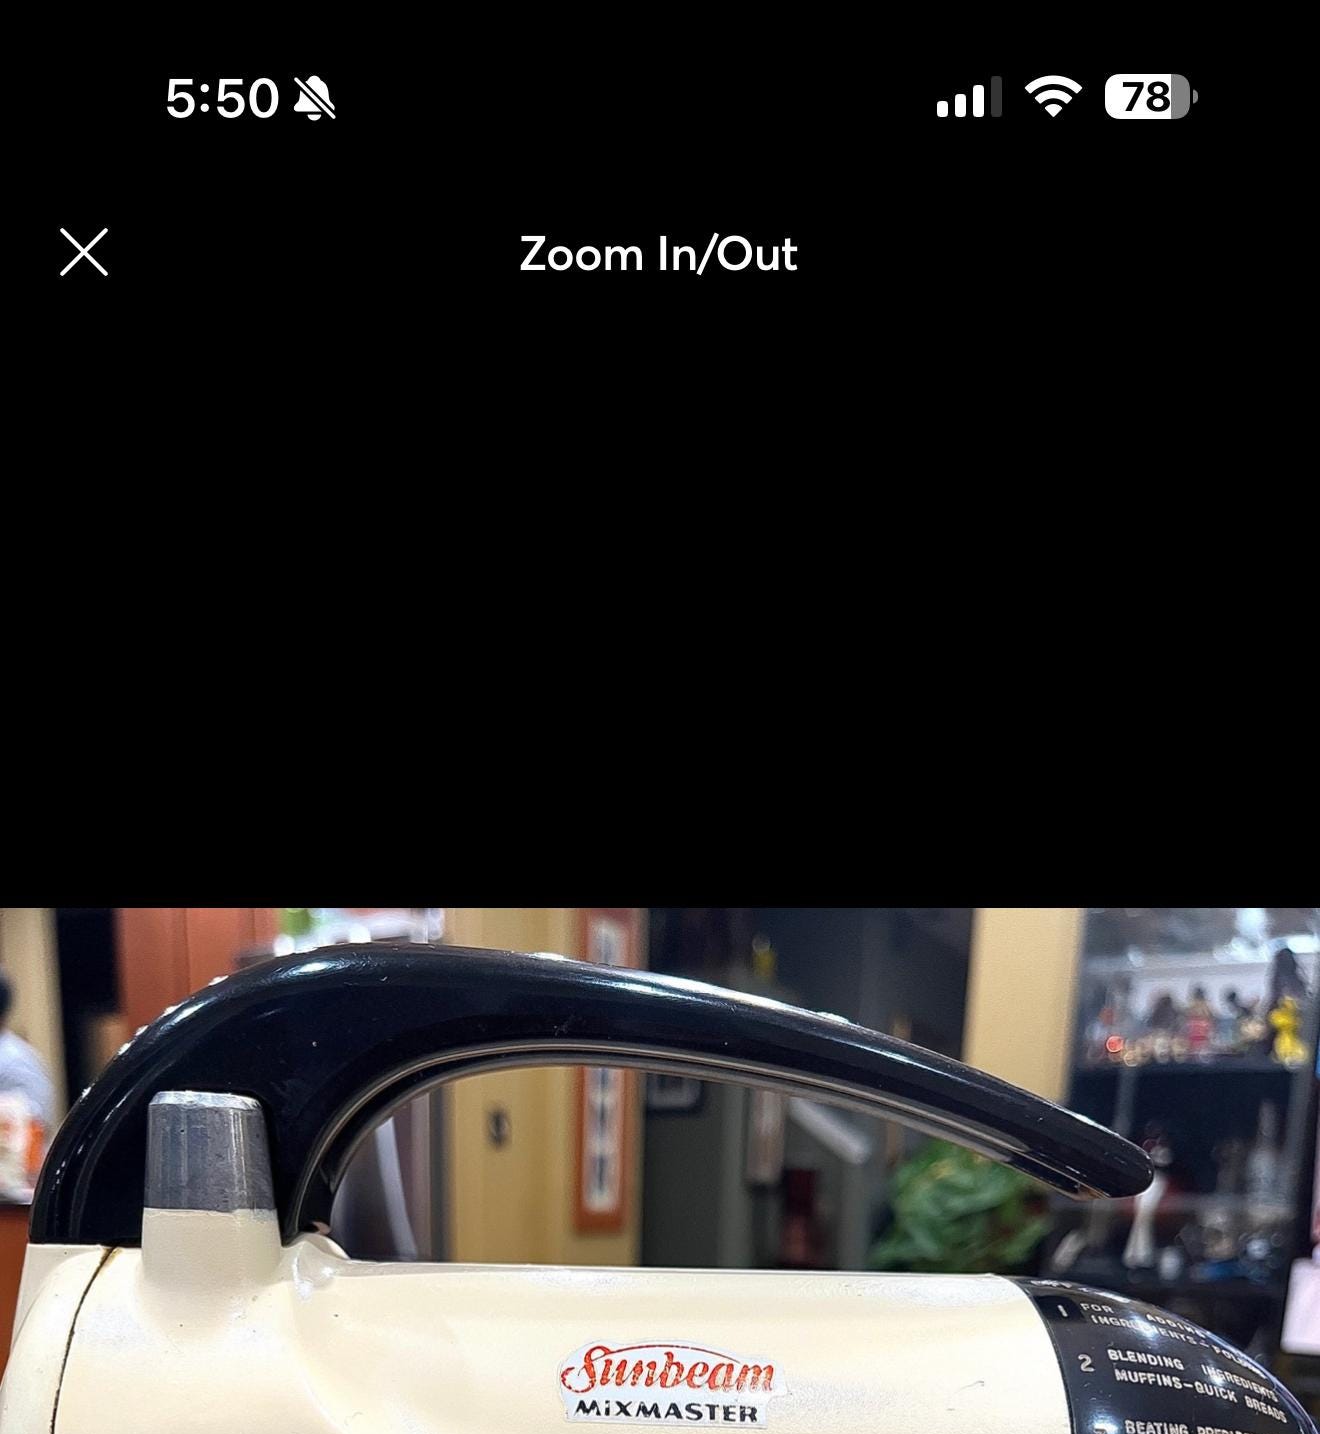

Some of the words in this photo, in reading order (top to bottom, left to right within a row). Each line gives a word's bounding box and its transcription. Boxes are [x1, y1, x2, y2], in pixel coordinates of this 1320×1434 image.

[1056, 1304, 1069, 1318] 1
[1080, 1303, 1114, 1314] FOR
[560, 1345, 775, 1393] Sunbeam
[1078, 1354, 1095, 1372] 2
[1107, 1348, 1184, 1371] BLENDING
[1201, 1364, 1279, 1403] INGREDIENTS
[1244, 1395, 1288, 1424] BREADS
